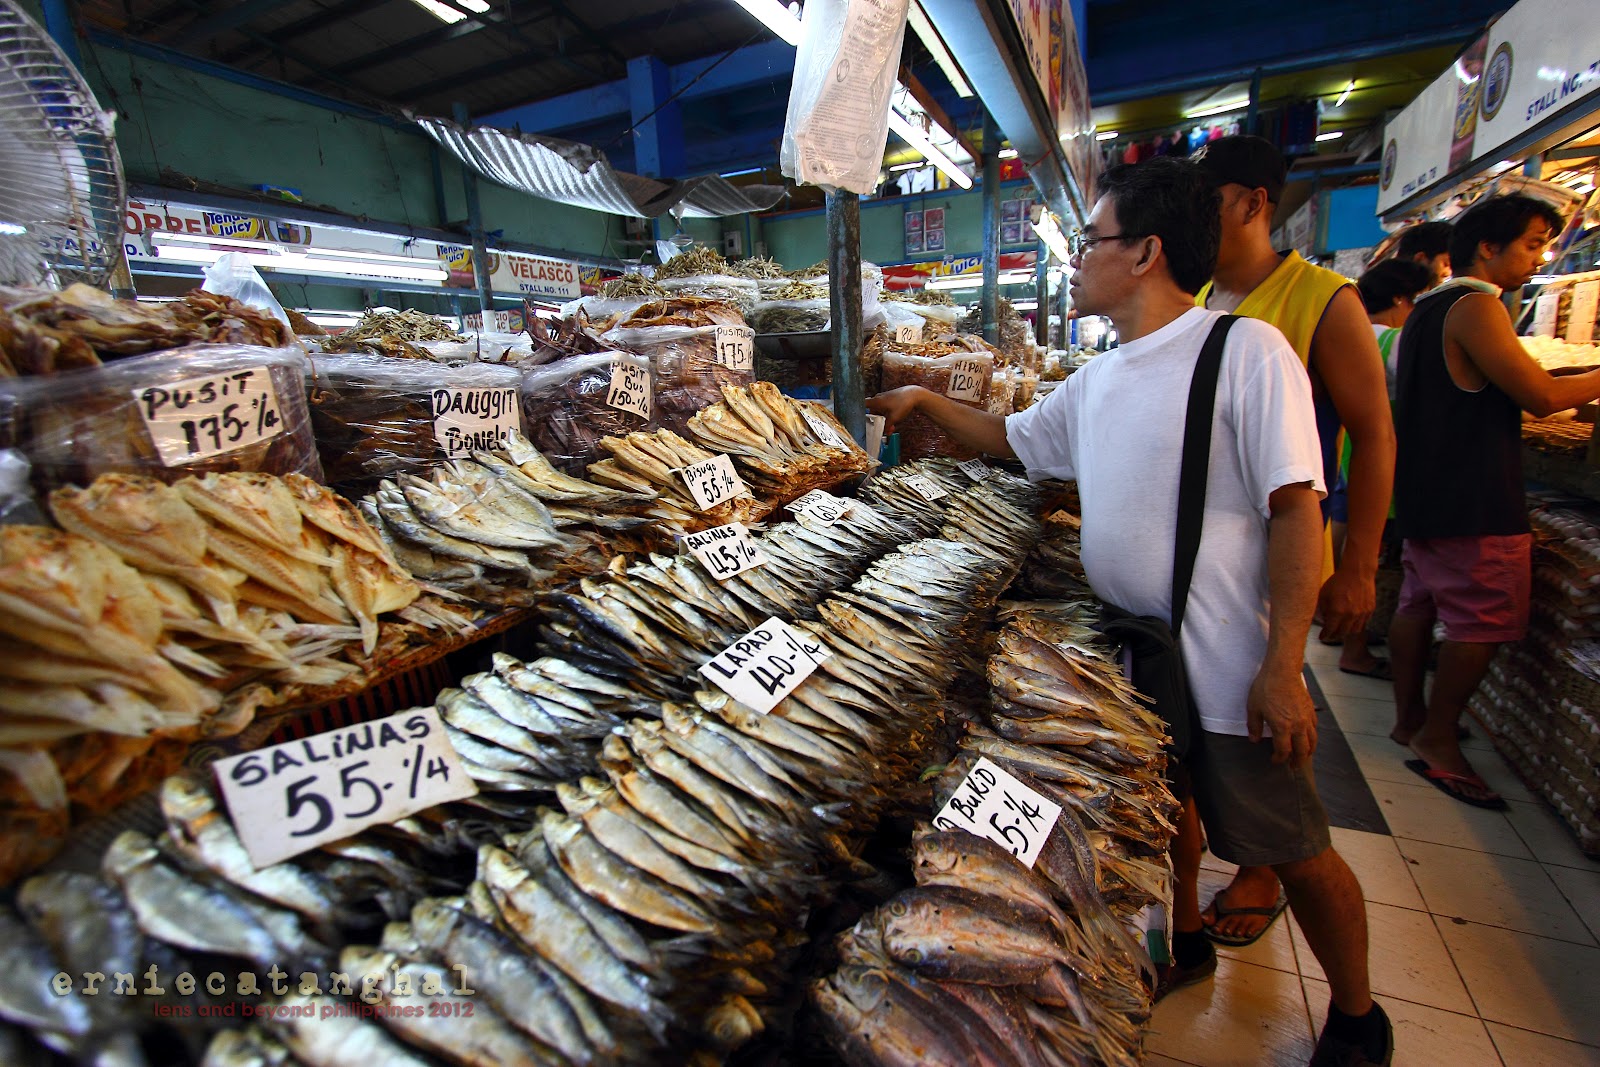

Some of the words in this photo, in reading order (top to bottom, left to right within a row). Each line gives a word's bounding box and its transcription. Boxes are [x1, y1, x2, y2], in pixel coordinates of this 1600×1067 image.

[1525, 87, 1557, 121] STALL
[124, 210, 202, 235] ORRE
[510, 261, 573, 284] VELASCO
[520, 283, 543, 293] STALL
[545, 285, 557, 294] NO.
[558, 287, 569, 295] 111
[708, 629, 774, 679] LAPAD
